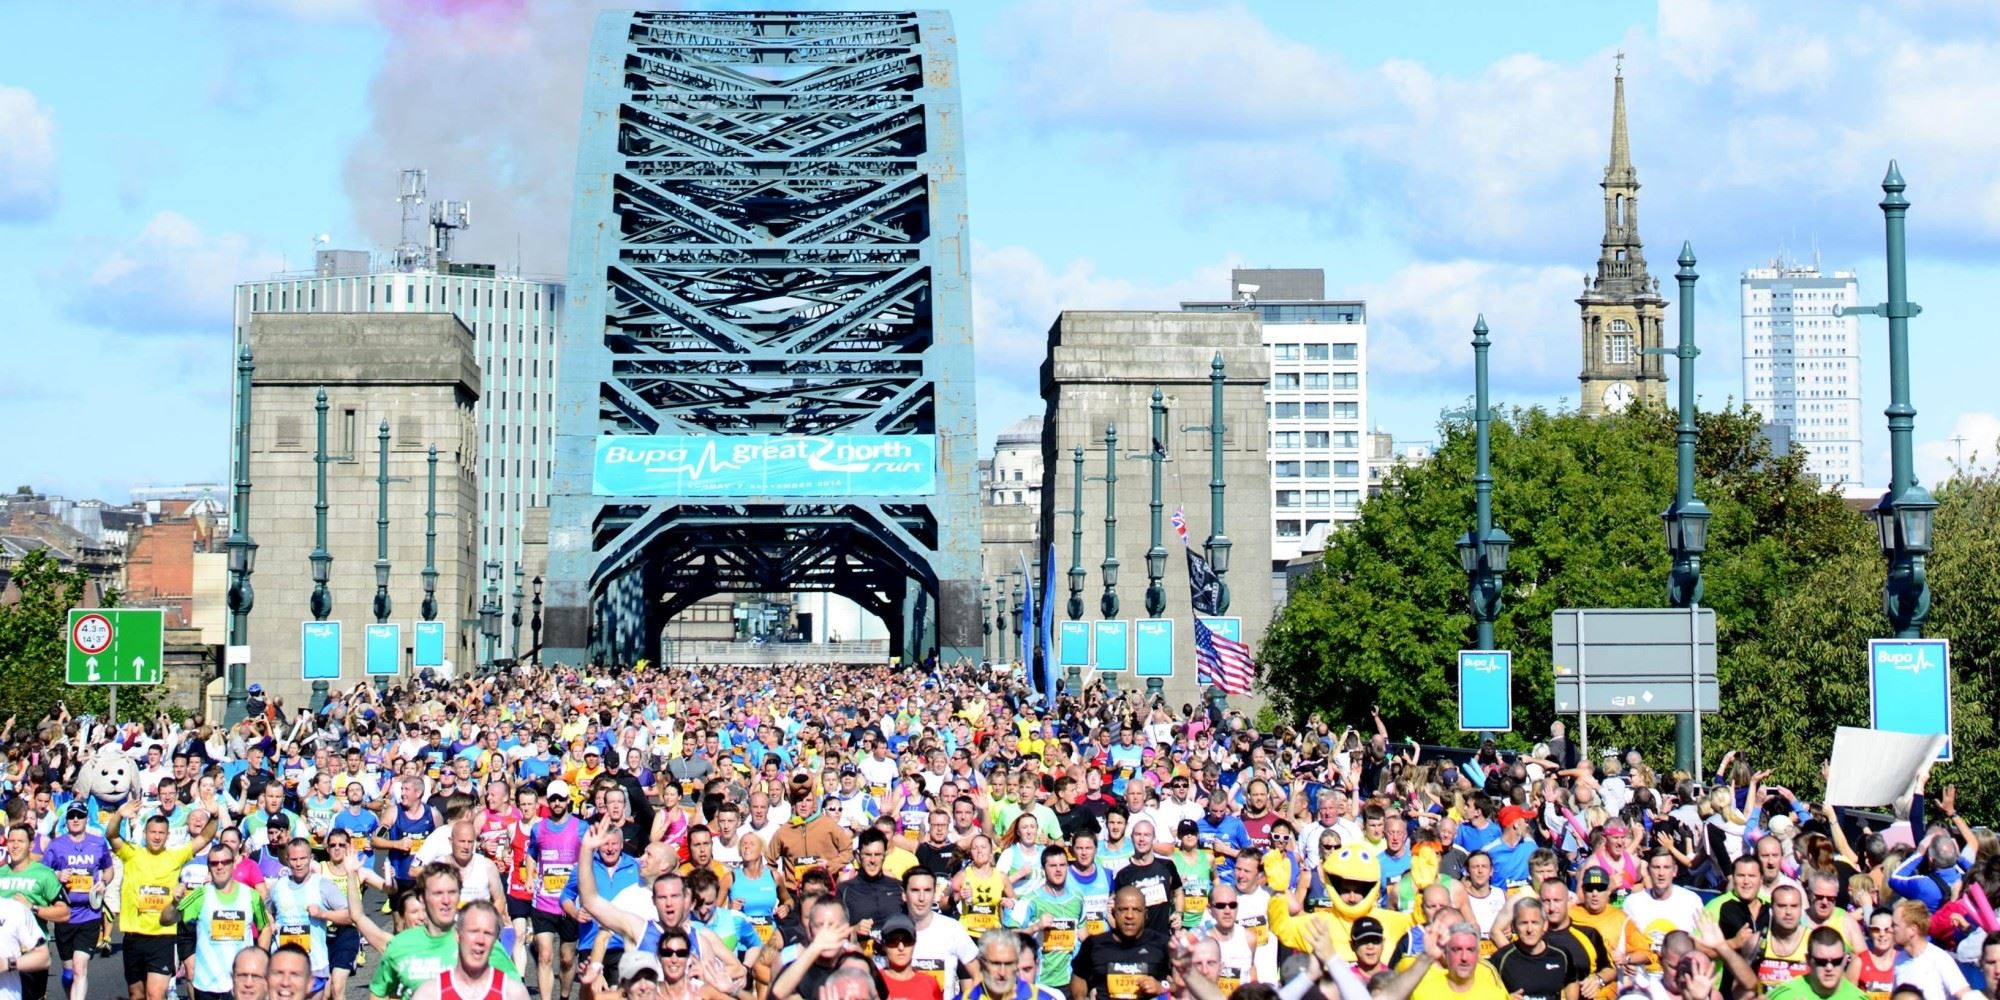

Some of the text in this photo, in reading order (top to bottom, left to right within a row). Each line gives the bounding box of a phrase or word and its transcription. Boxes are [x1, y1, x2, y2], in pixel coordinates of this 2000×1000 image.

[605, 440, 912, 465] Bupa great north
[872, 462, 922, 473] run
[81, 624, 97, 632] 4.3
[1878, 650, 1912, 664] Bupa
[67, 854, 94, 865] DAN
